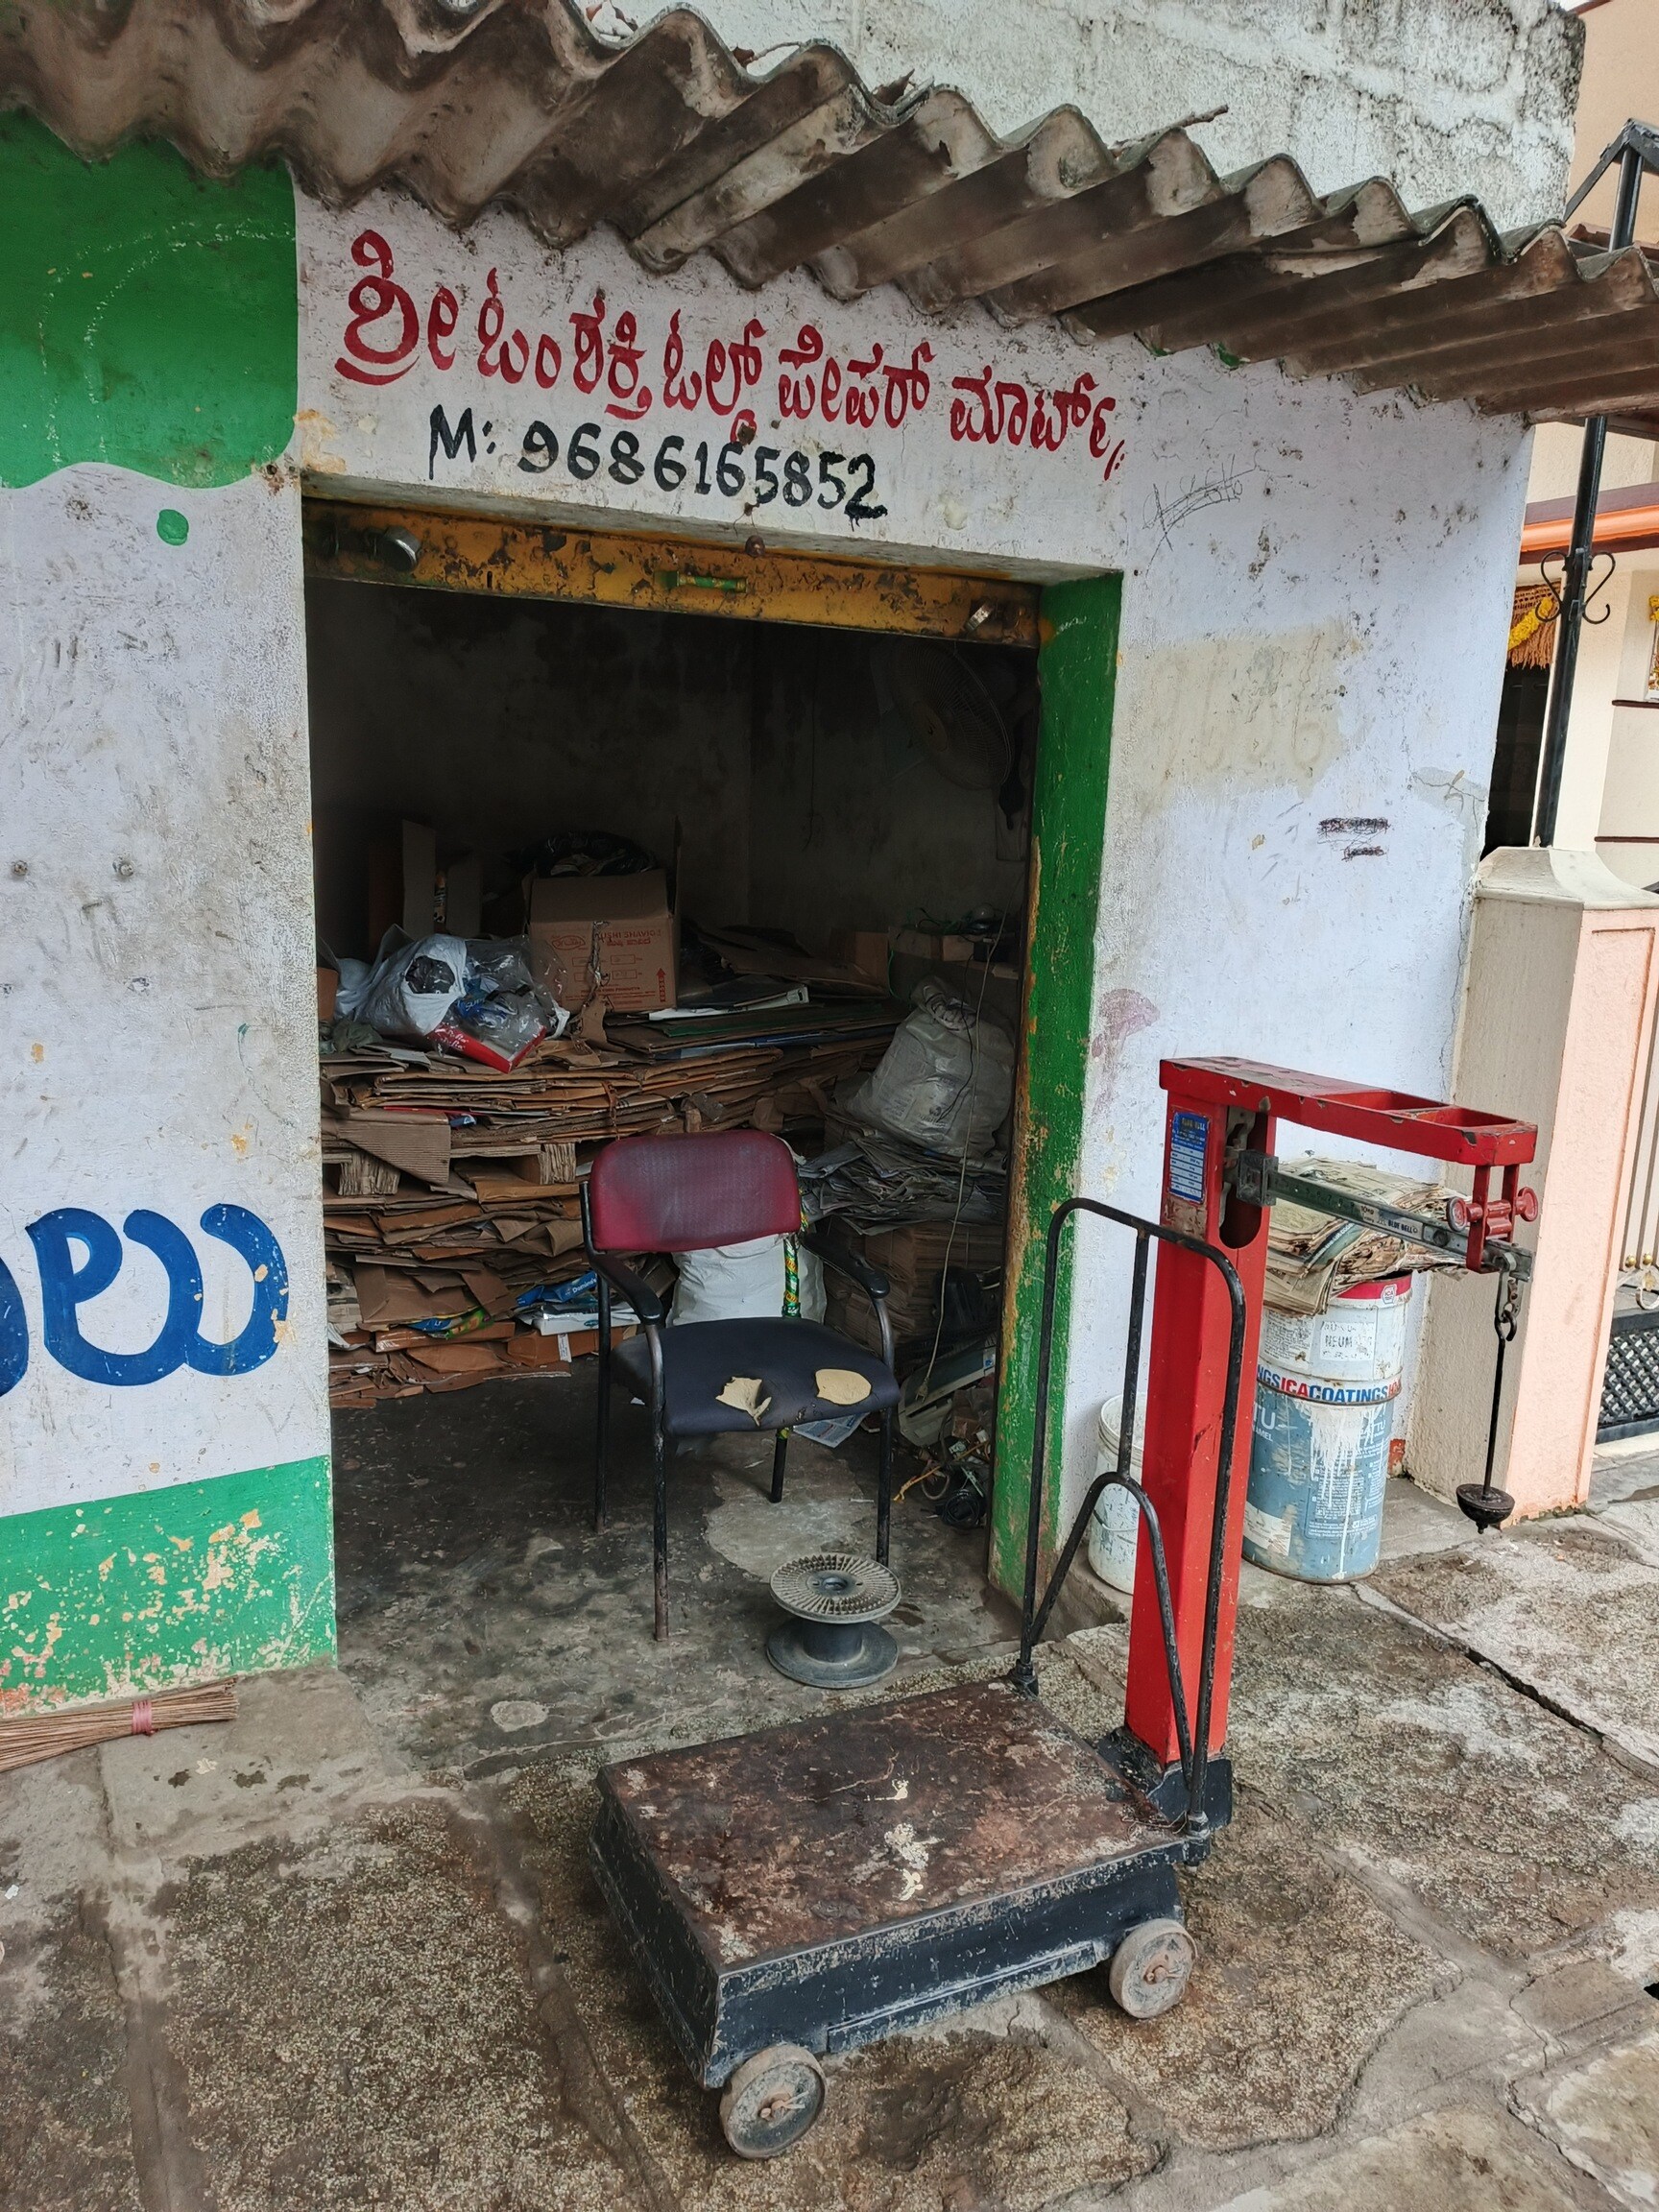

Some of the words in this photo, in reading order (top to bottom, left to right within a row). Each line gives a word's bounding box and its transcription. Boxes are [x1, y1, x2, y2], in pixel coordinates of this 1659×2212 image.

[334, 228, 459, 386] ಶ್ರೀ
[476, 267, 562, 389] ಓಂ
[778, 324, 938, 429] ಪೇಪರ್
[517, 420, 888, 532] 9686165852
[1401, 1223, 1413, 1234] BELL
